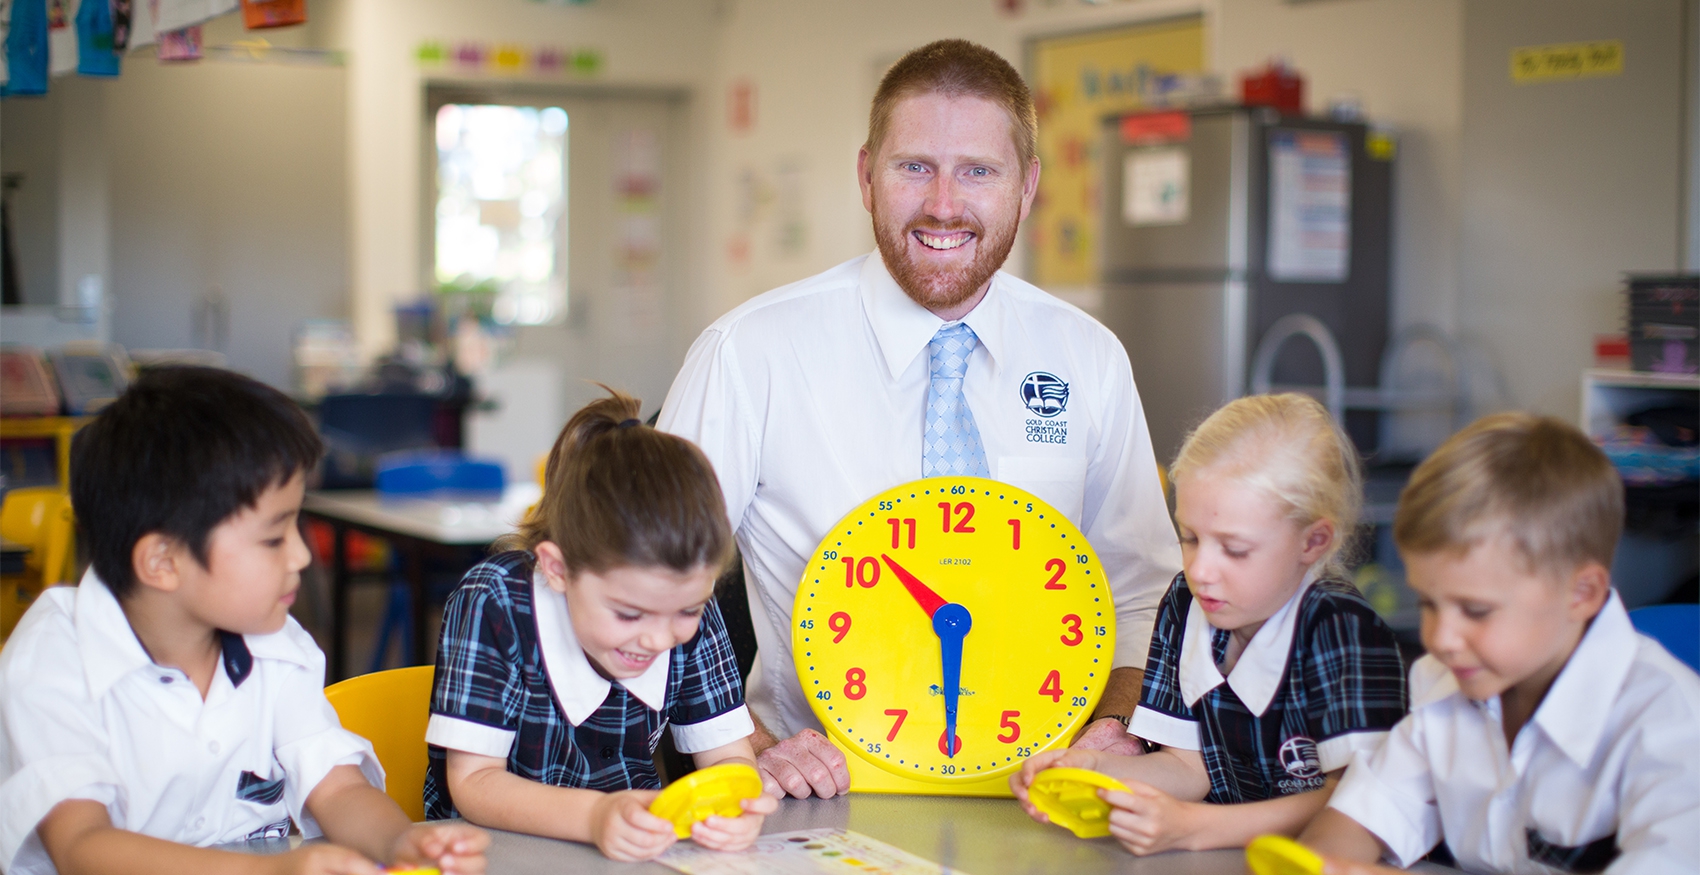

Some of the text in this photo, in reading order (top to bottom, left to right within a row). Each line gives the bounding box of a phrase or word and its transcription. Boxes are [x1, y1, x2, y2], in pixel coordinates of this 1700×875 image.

[1025, 426, 1067, 435] CHRISTIAN
[1026, 434, 1067, 444] COLLEGE
[950, 485, 966, 495] 60
[878, 501, 893, 511] 55
[1025, 503, 1033, 513] 5
[938, 502, 976, 533] 12
[887, 518, 916, 549] 11
[1008, 519, 1020, 550] 1
[823, 550, 838, 560] 50
[1076, 554, 1088, 564] 10
[939, 558, 972, 566] LER 2102
[841, 556, 881, 588] 10
[1044, 558, 1067, 590] 2
[800, 619, 814, 629] 45
[828, 612, 851, 644] 9
[1060, 614, 1083, 646] 3
[1094, 626, 1106, 636] 15
[843, 667, 867, 700] 8
[1038, 669, 1064, 703] 4
[816, 690, 832, 701] 40
[1071, 697, 1087, 707] 20
[884, 709, 908, 742] 7
[997, 710, 1021, 744] 5
[866, 744, 882, 754] 35
[1016, 747, 1031, 757] 25
[941, 764, 956, 775] 30
